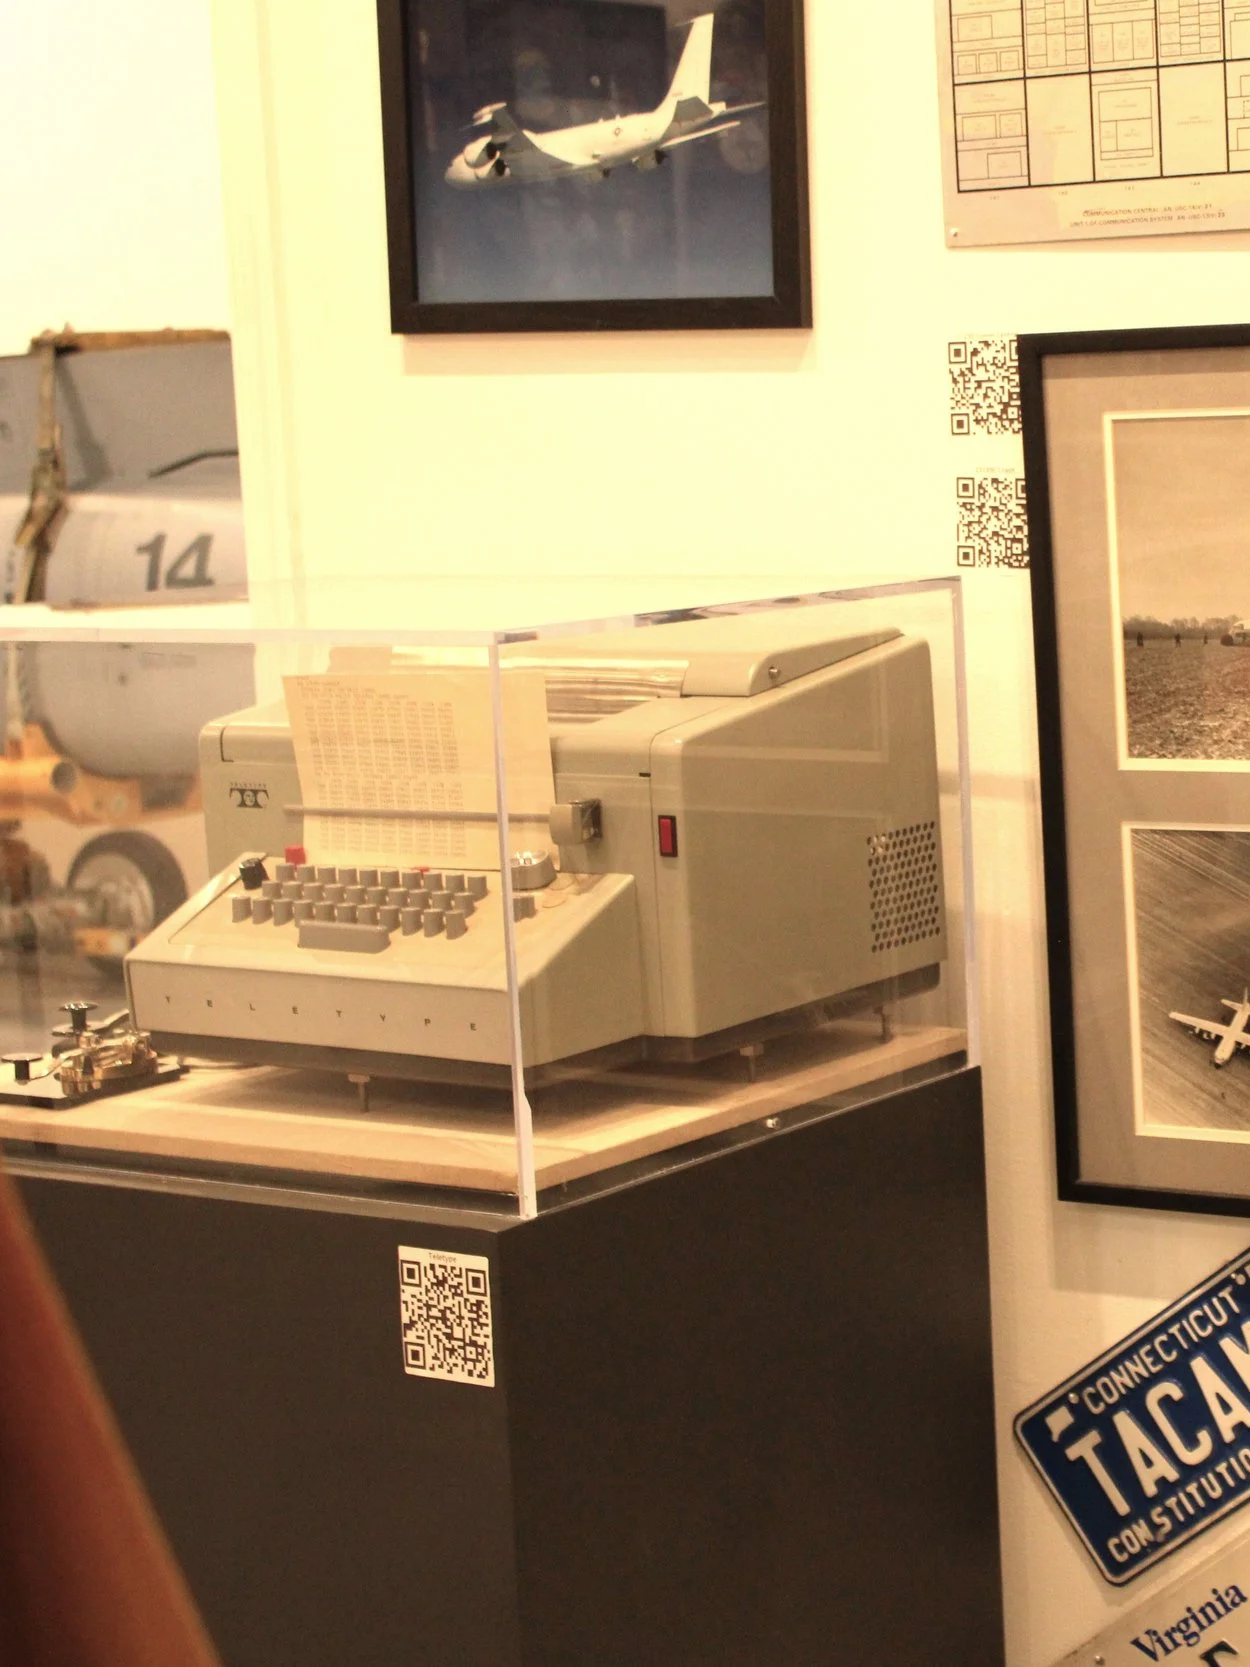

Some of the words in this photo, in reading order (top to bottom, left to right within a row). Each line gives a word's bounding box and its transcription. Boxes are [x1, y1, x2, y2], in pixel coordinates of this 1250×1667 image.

[136, 532, 214, 592] 14
[165, 995, 478, 1032] TELETYPE
[428, 1252, 457, 1263] Teletype
[1083, 1286, 1240, 1415] CONNECTICUT
[1130, 1584, 1249, 1663] Virginia
